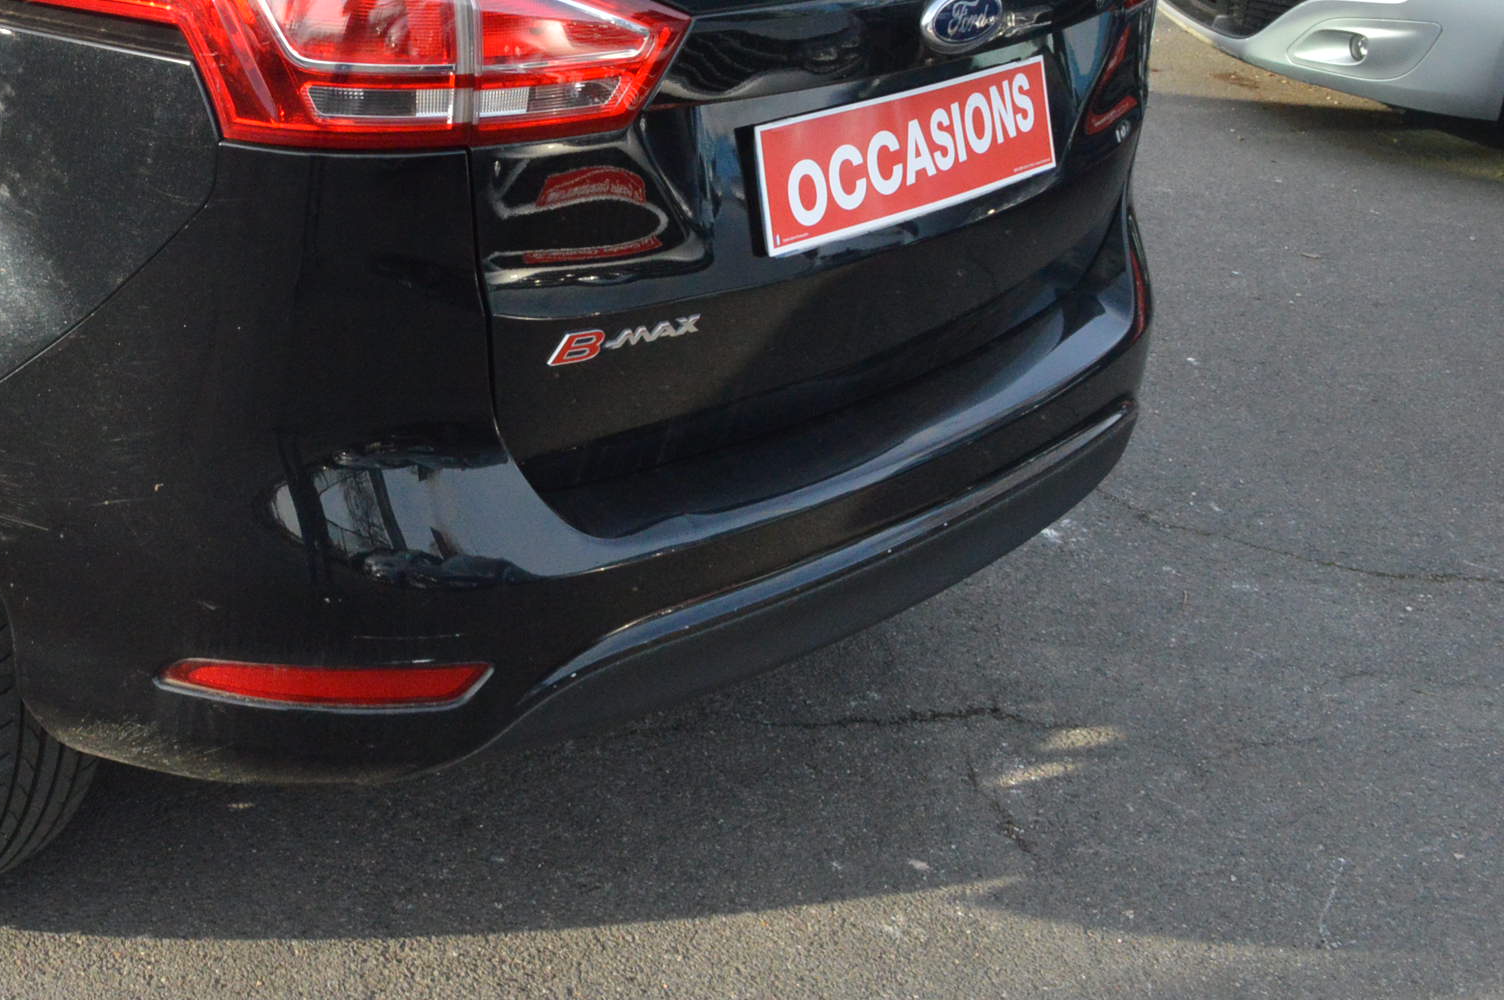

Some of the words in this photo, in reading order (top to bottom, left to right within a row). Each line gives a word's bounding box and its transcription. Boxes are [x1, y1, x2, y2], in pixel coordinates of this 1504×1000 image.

[947, 0, 992, 37] Ford
[787, 72, 1035, 227] OCCASIONS
[547, 313, 702, 367] B-MAX
